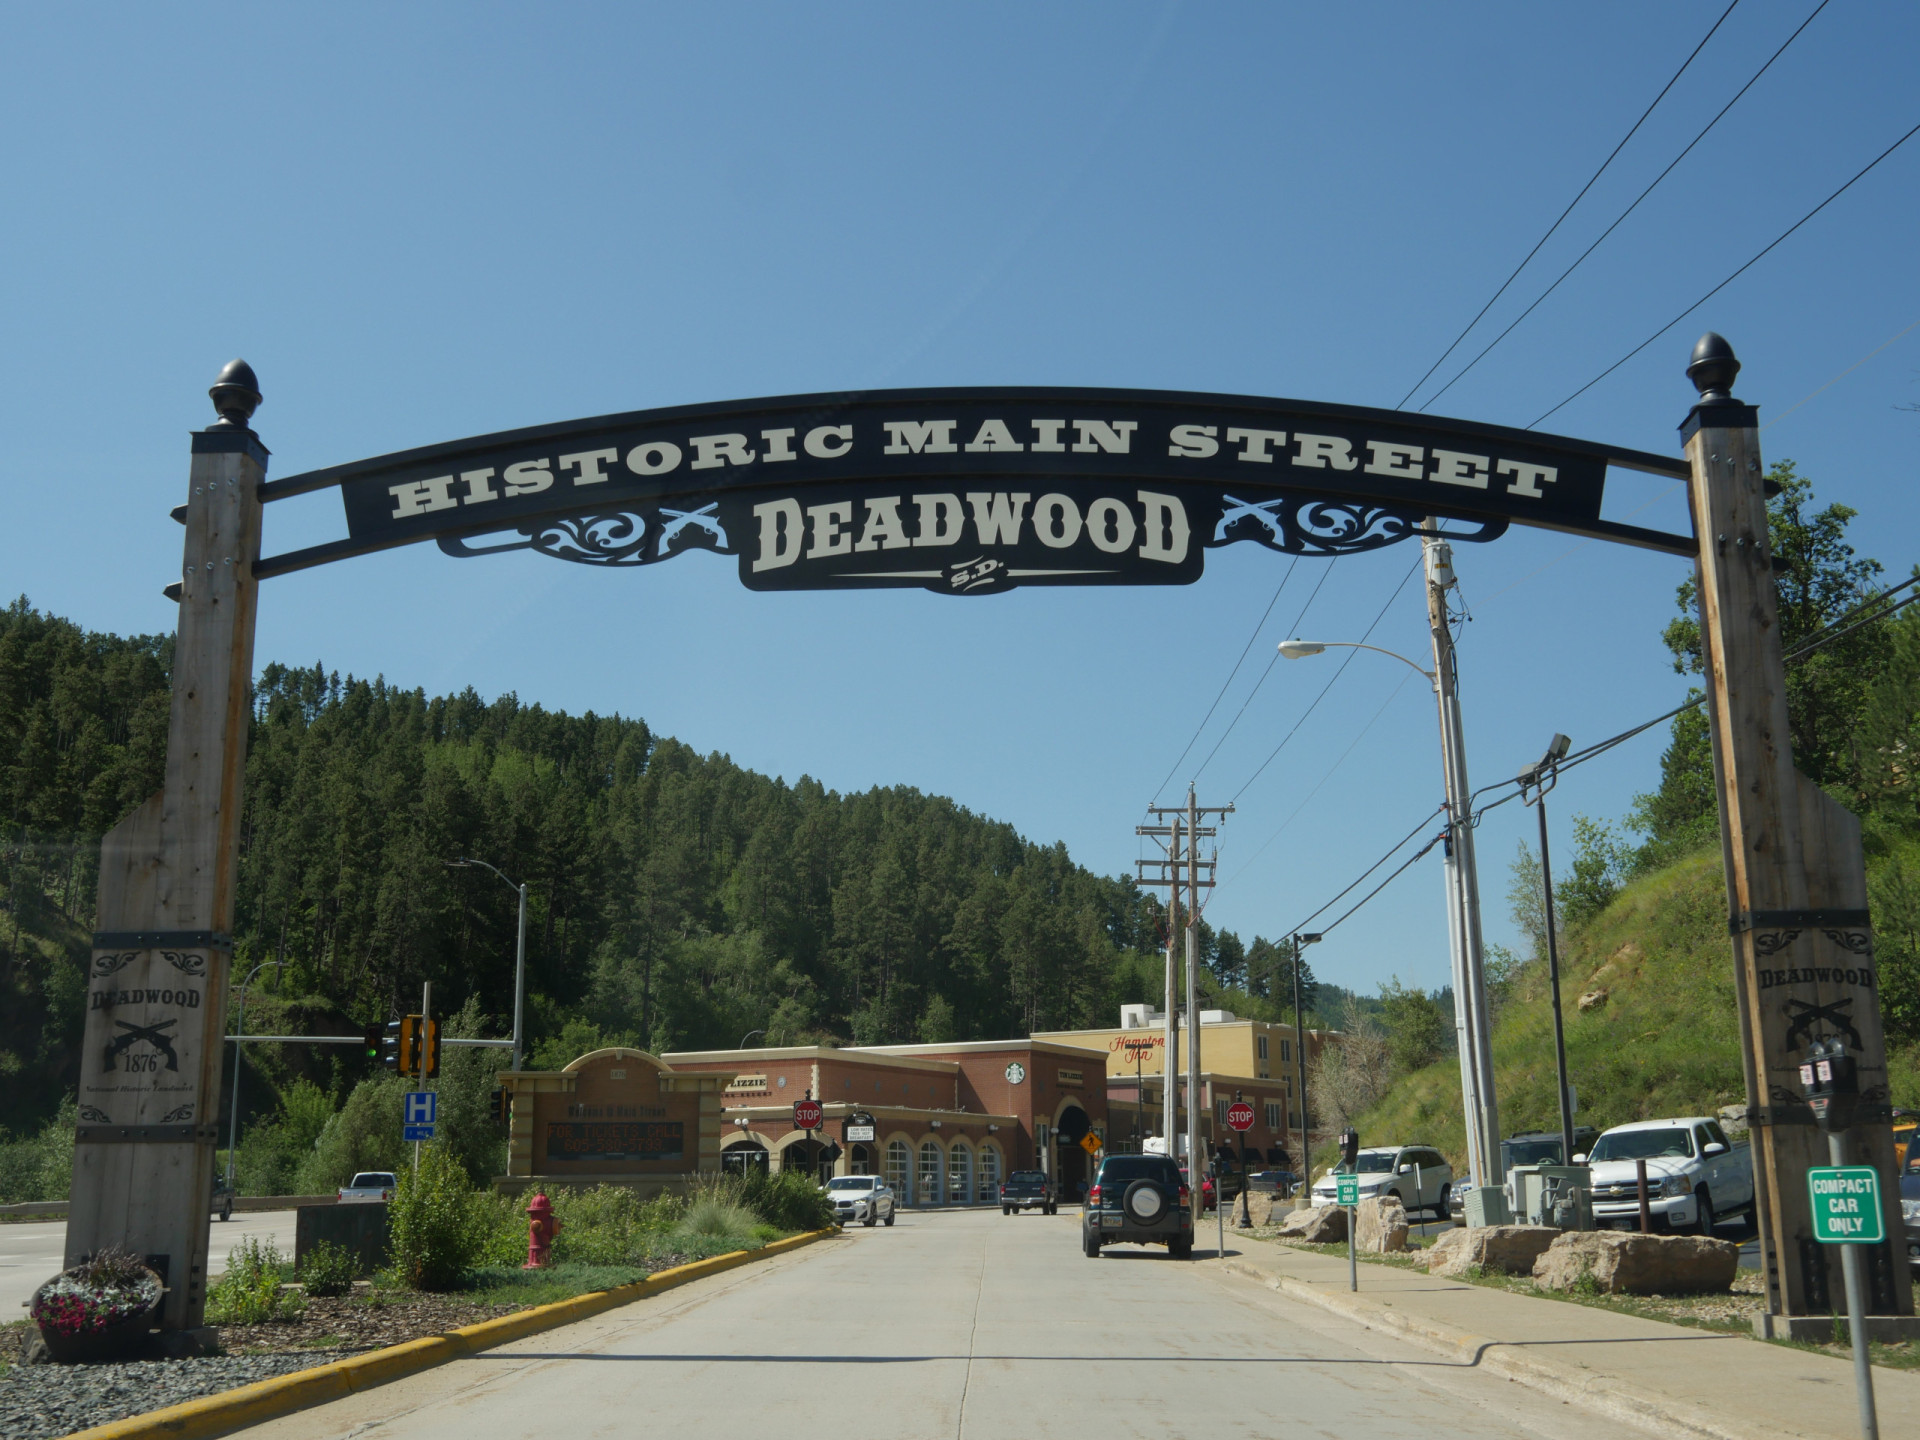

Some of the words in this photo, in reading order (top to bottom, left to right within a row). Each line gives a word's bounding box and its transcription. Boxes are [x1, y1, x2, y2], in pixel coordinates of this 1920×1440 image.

[388, 424, 854, 519] HISTORIC
[883, 420, 1138, 455] MAIN
[1168, 424, 1558, 499] STREET
[753, 490, 1191, 573] DEADWOOD
[951, 559, 1004, 588] S.D.
[1760, 967, 1872, 989] DEADWOOD
[91, 988, 200, 1011] DEADWOOD
[1109, 1035, 1165, 1052] Hampton
[124, 1054, 157, 1072] 1876
[1125, 1048, 1153, 1064] Inn
[409, 1094, 432, 1122] H
[796, 1109, 820, 1121] STOP
[1229, 1111, 1252, 1122] STOP
[548, 1124, 574, 1138] FOR
[583, 1124, 639, 1138] TICKETS
[647, 1124, 681, 1138] CALL
[1813, 1178, 1873, 1194] COMPACT
[1828, 1198, 1859, 1213] CAR
[1828, 1217, 1864, 1232] ONLY
